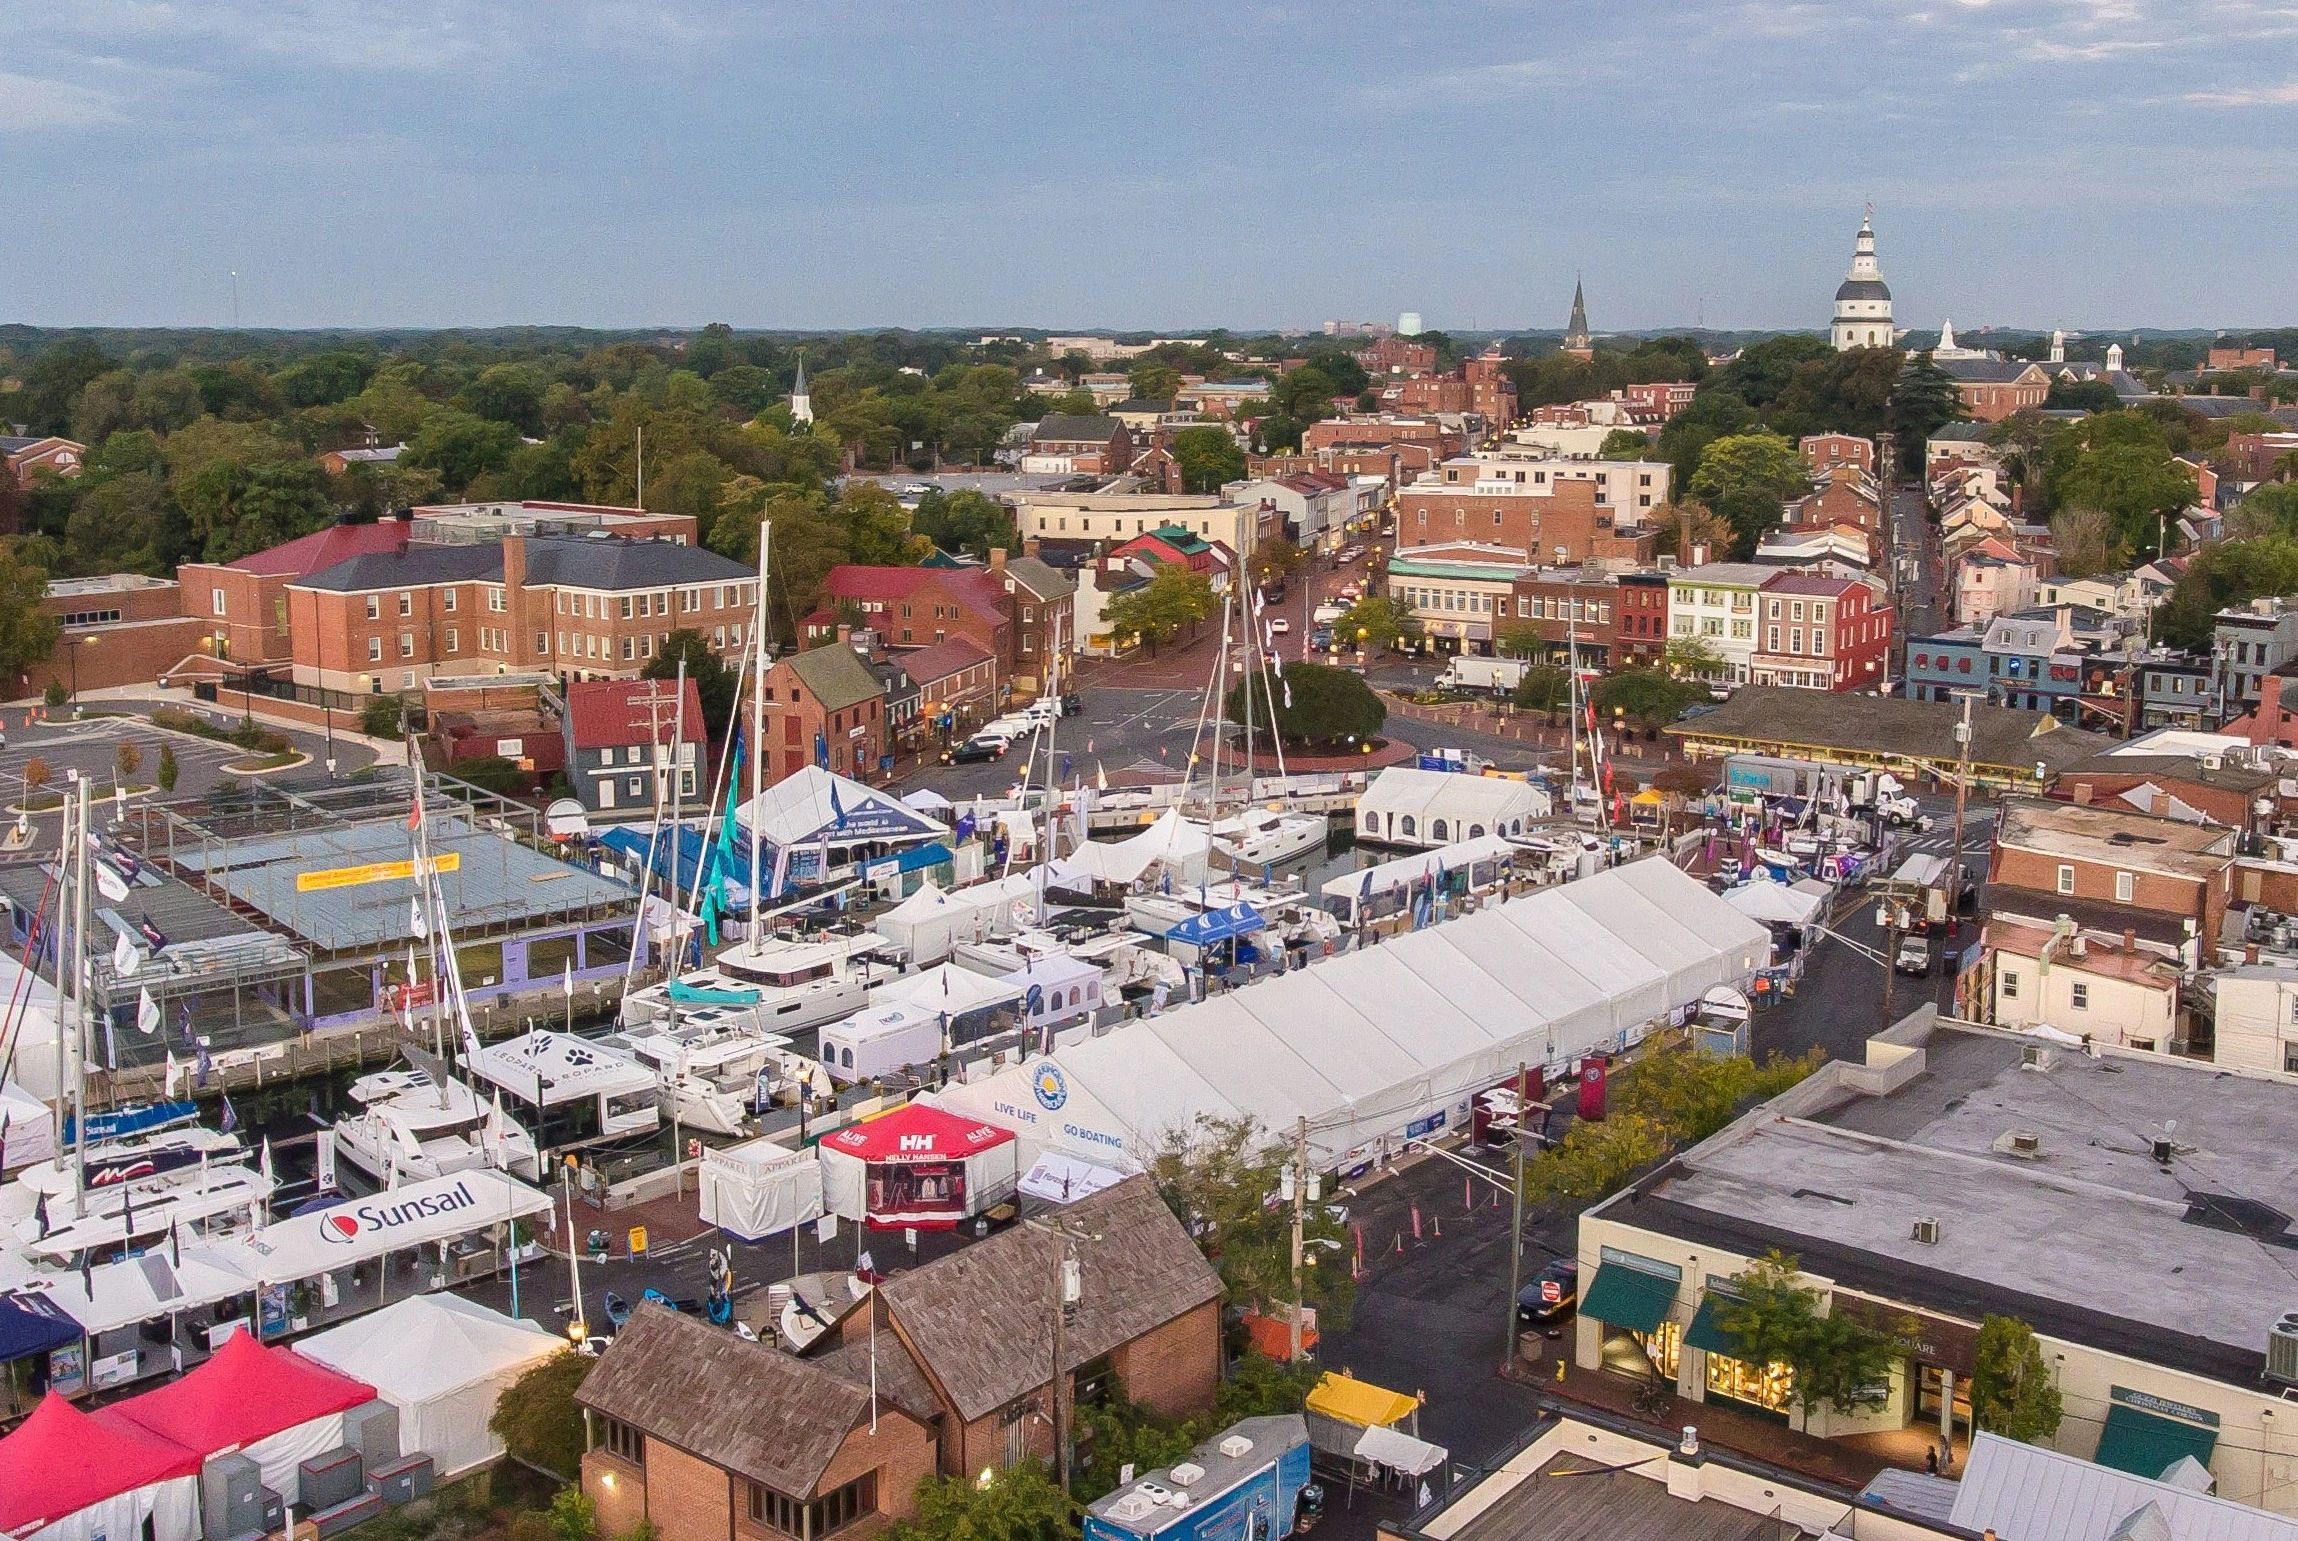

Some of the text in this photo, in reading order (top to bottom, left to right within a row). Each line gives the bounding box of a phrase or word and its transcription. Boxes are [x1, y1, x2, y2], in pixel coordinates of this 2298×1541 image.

[493, 1050, 543, 1076] LEOPARD
[551, 1061, 625, 1082] LEOPARD
[994, 1101, 1037, 1124] LIVE LIFE
[841, 1129, 869, 1146] ALIVE
[899, 1134, 934, 1151] HH
[965, 1125, 994, 1140] ALIVE
[1064, 1124, 1122, 1149] GO BOATING
[708, 1153, 746, 1175] APPAREL
[764, 1153, 808, 1175] APPAREL
[886, 1152, 947, 1162] HELLY HANSEN
[357, 1181, 476, 1232] Sunsail
